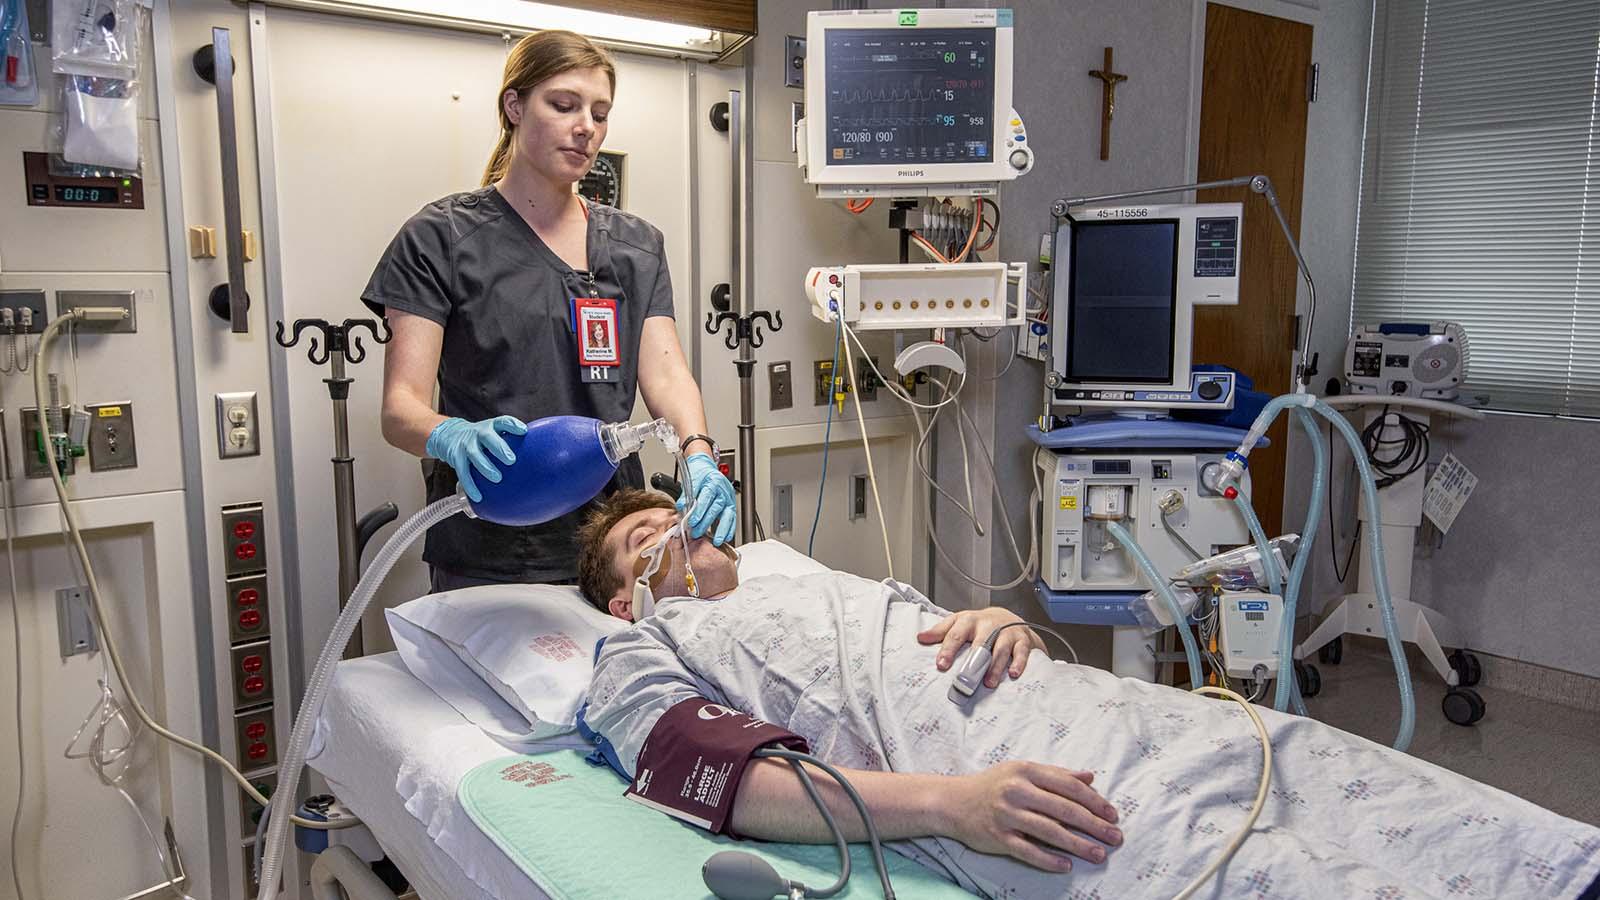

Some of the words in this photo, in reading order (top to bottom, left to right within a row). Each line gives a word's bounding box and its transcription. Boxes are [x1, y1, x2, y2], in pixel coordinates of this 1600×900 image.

[944, 51, 957, 64] 60
[944, 90, 954, 101] 15
[943, 115, 955, 126] 95
[842, 131, 871, 143] 120/80
[875, 131, 893, 143] (90)
[1096, 208, 1148, 218] 45-115556
[590, 366, 609, 380] RT
[694, 765, 710, 801] LARGE
[700, 766, 715, 803] ADULT
